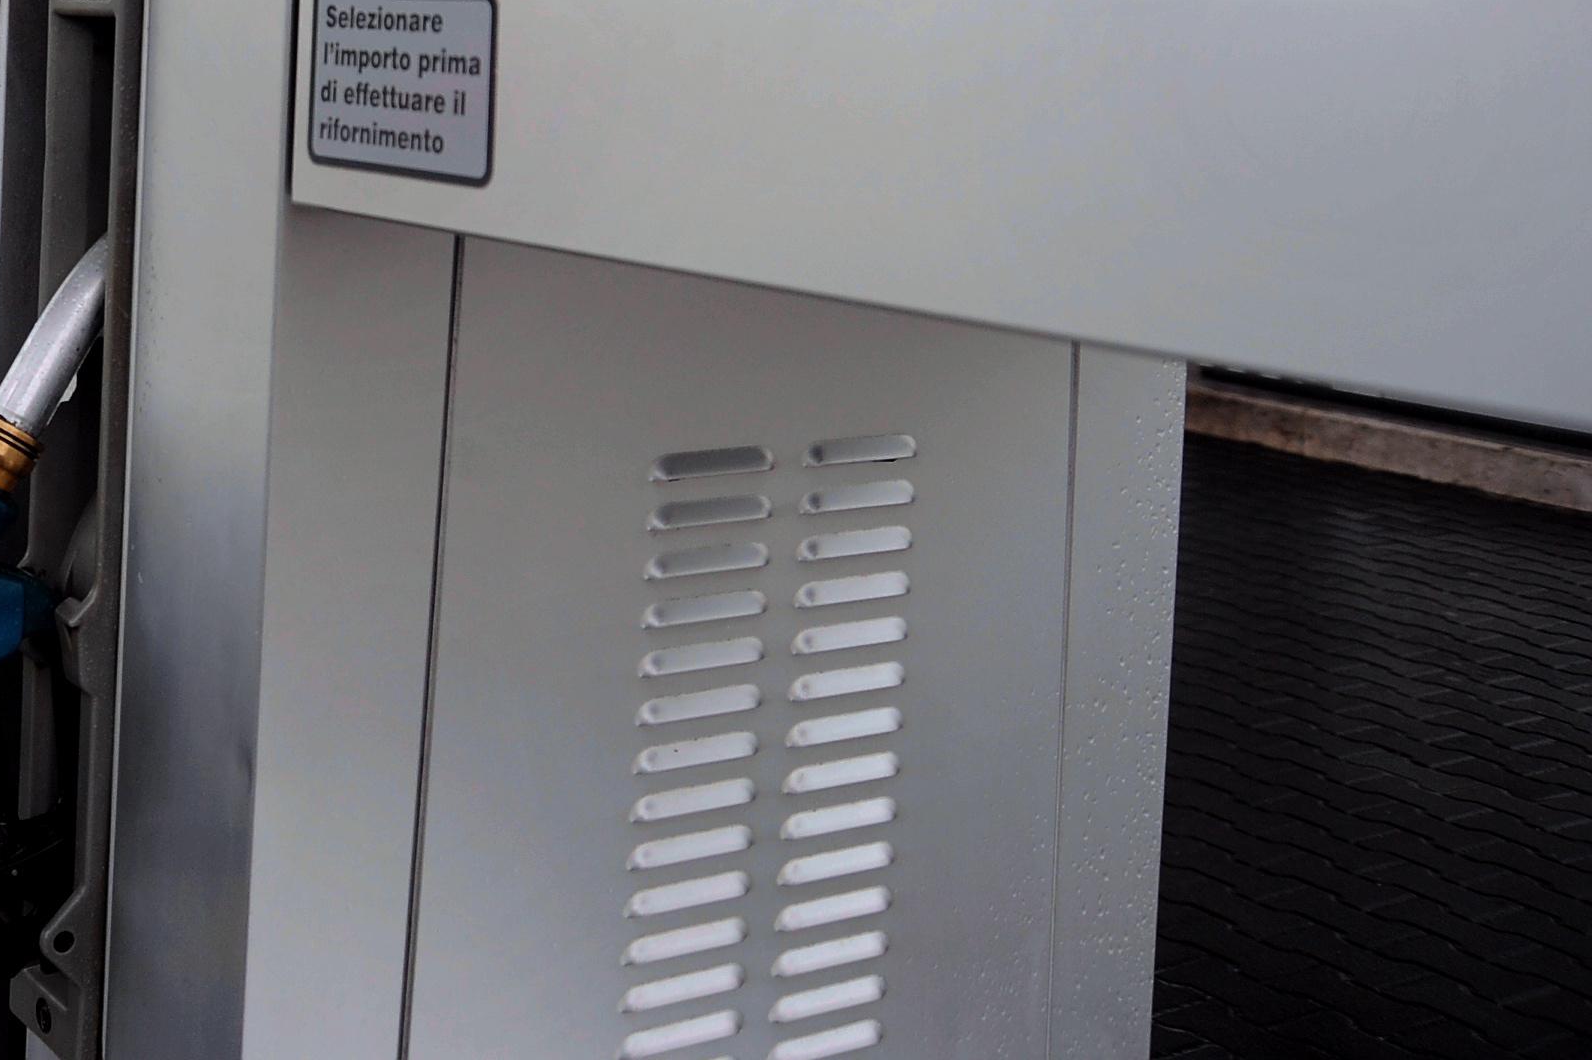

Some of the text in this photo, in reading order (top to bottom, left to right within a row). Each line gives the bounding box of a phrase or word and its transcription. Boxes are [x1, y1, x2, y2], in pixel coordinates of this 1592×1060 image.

[326, 5, 444, 33] Selezionare
[323, 42, 482, 78] l'importo prima
[320, 80, 467, 115] di effettuare il
[319, 117, 445, 154] rifornimento
